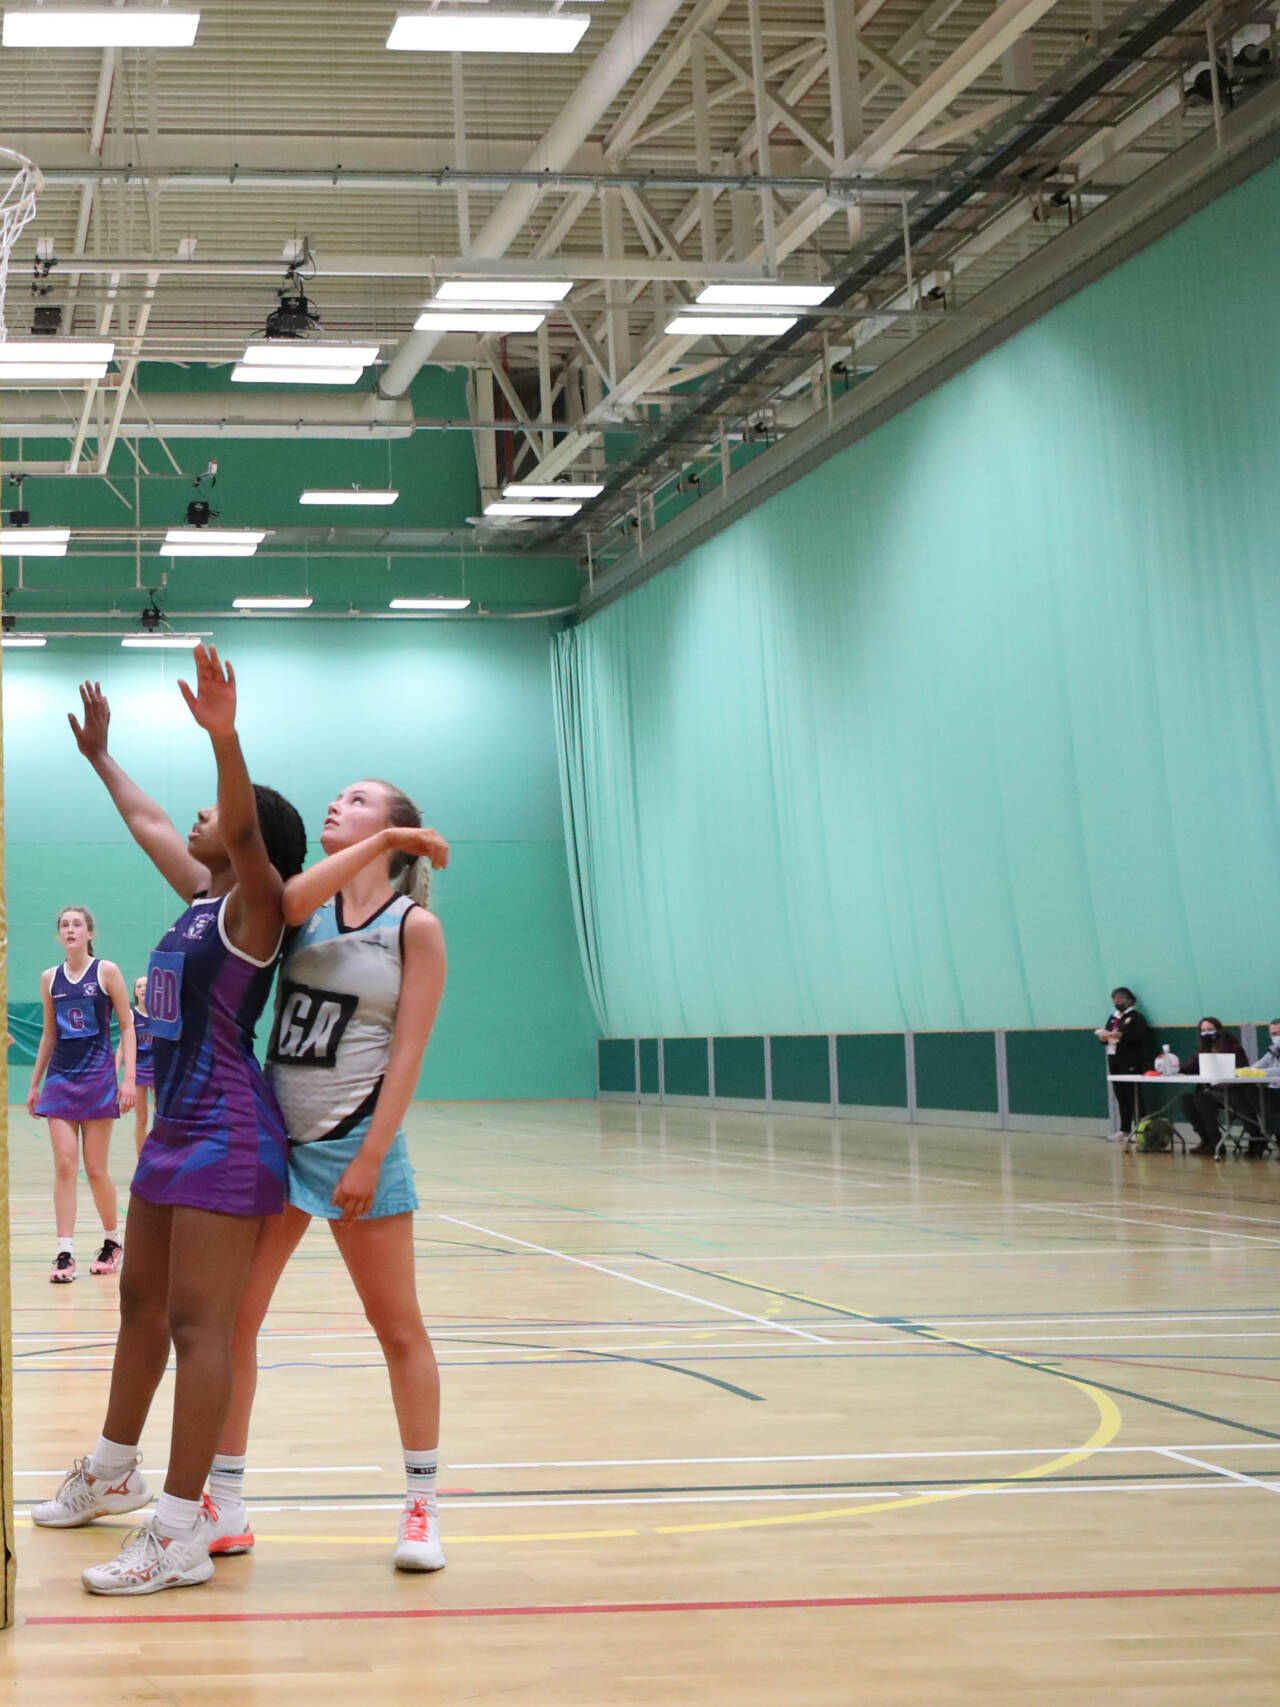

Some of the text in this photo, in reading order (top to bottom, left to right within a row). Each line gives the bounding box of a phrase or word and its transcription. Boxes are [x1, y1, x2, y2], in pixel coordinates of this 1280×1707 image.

[67, 1007, 84, 1032] C
[150, 966, 178, 1023] GD
[278, 992, 341, 1057] GA
